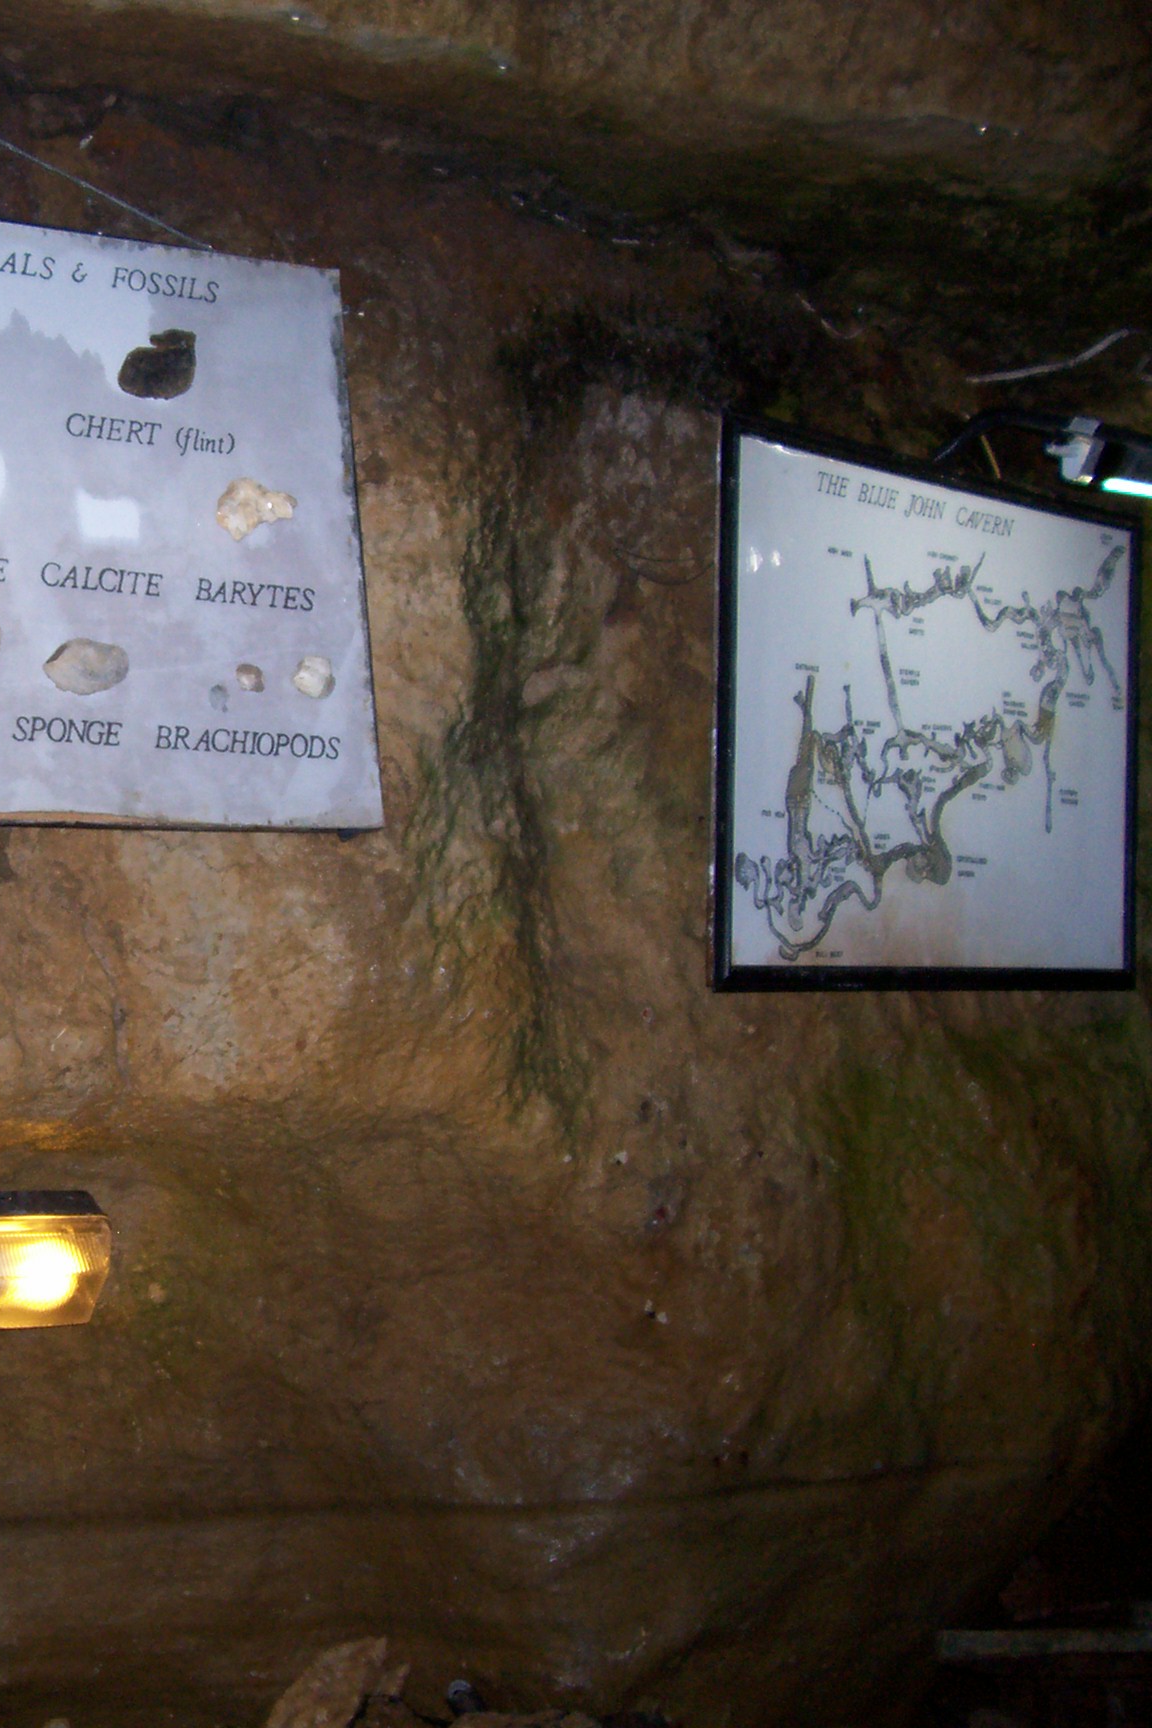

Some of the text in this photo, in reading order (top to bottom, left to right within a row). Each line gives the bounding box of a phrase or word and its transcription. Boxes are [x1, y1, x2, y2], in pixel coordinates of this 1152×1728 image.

[71, 262, 88, 284] &
[111, 266, 220, 304] FOSSILS
[65, 412, 236, 457] CHERT (flint)
[817, 470, 1016, 538] THE BLUE JOHN CAVERN
[40, 561, 164, 597] CALCITE
[195, 577, 316, 612] BARYTES
[11, 716, 123, 747] SPONGE
[154, 724, 341, 760] BRACHIOPODS
